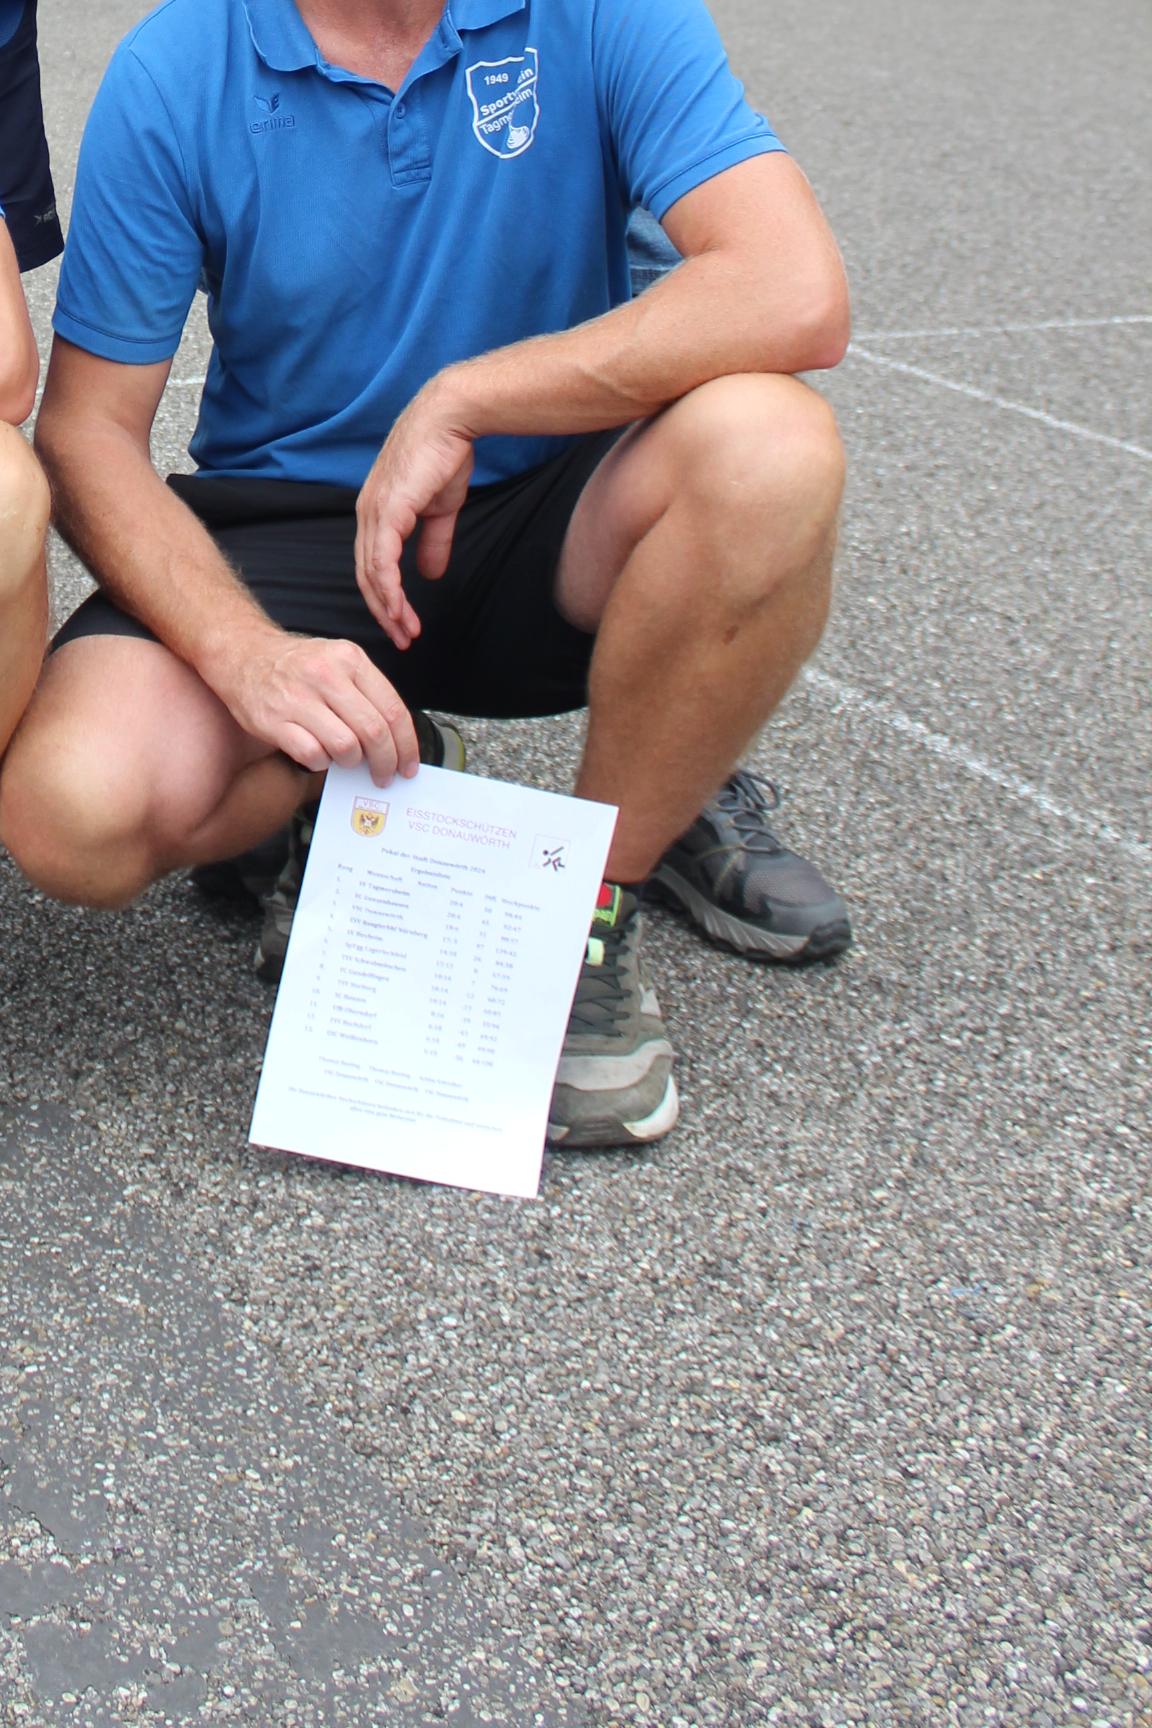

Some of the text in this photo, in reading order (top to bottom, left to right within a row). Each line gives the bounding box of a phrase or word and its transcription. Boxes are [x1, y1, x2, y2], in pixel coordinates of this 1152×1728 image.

[484, 73, 509, 85] 1949
[406, 807, 517, 839] EISSTOCKSCHÜTZEN
[408, 821, 511, 849] VSC DONAUWÖRTH
